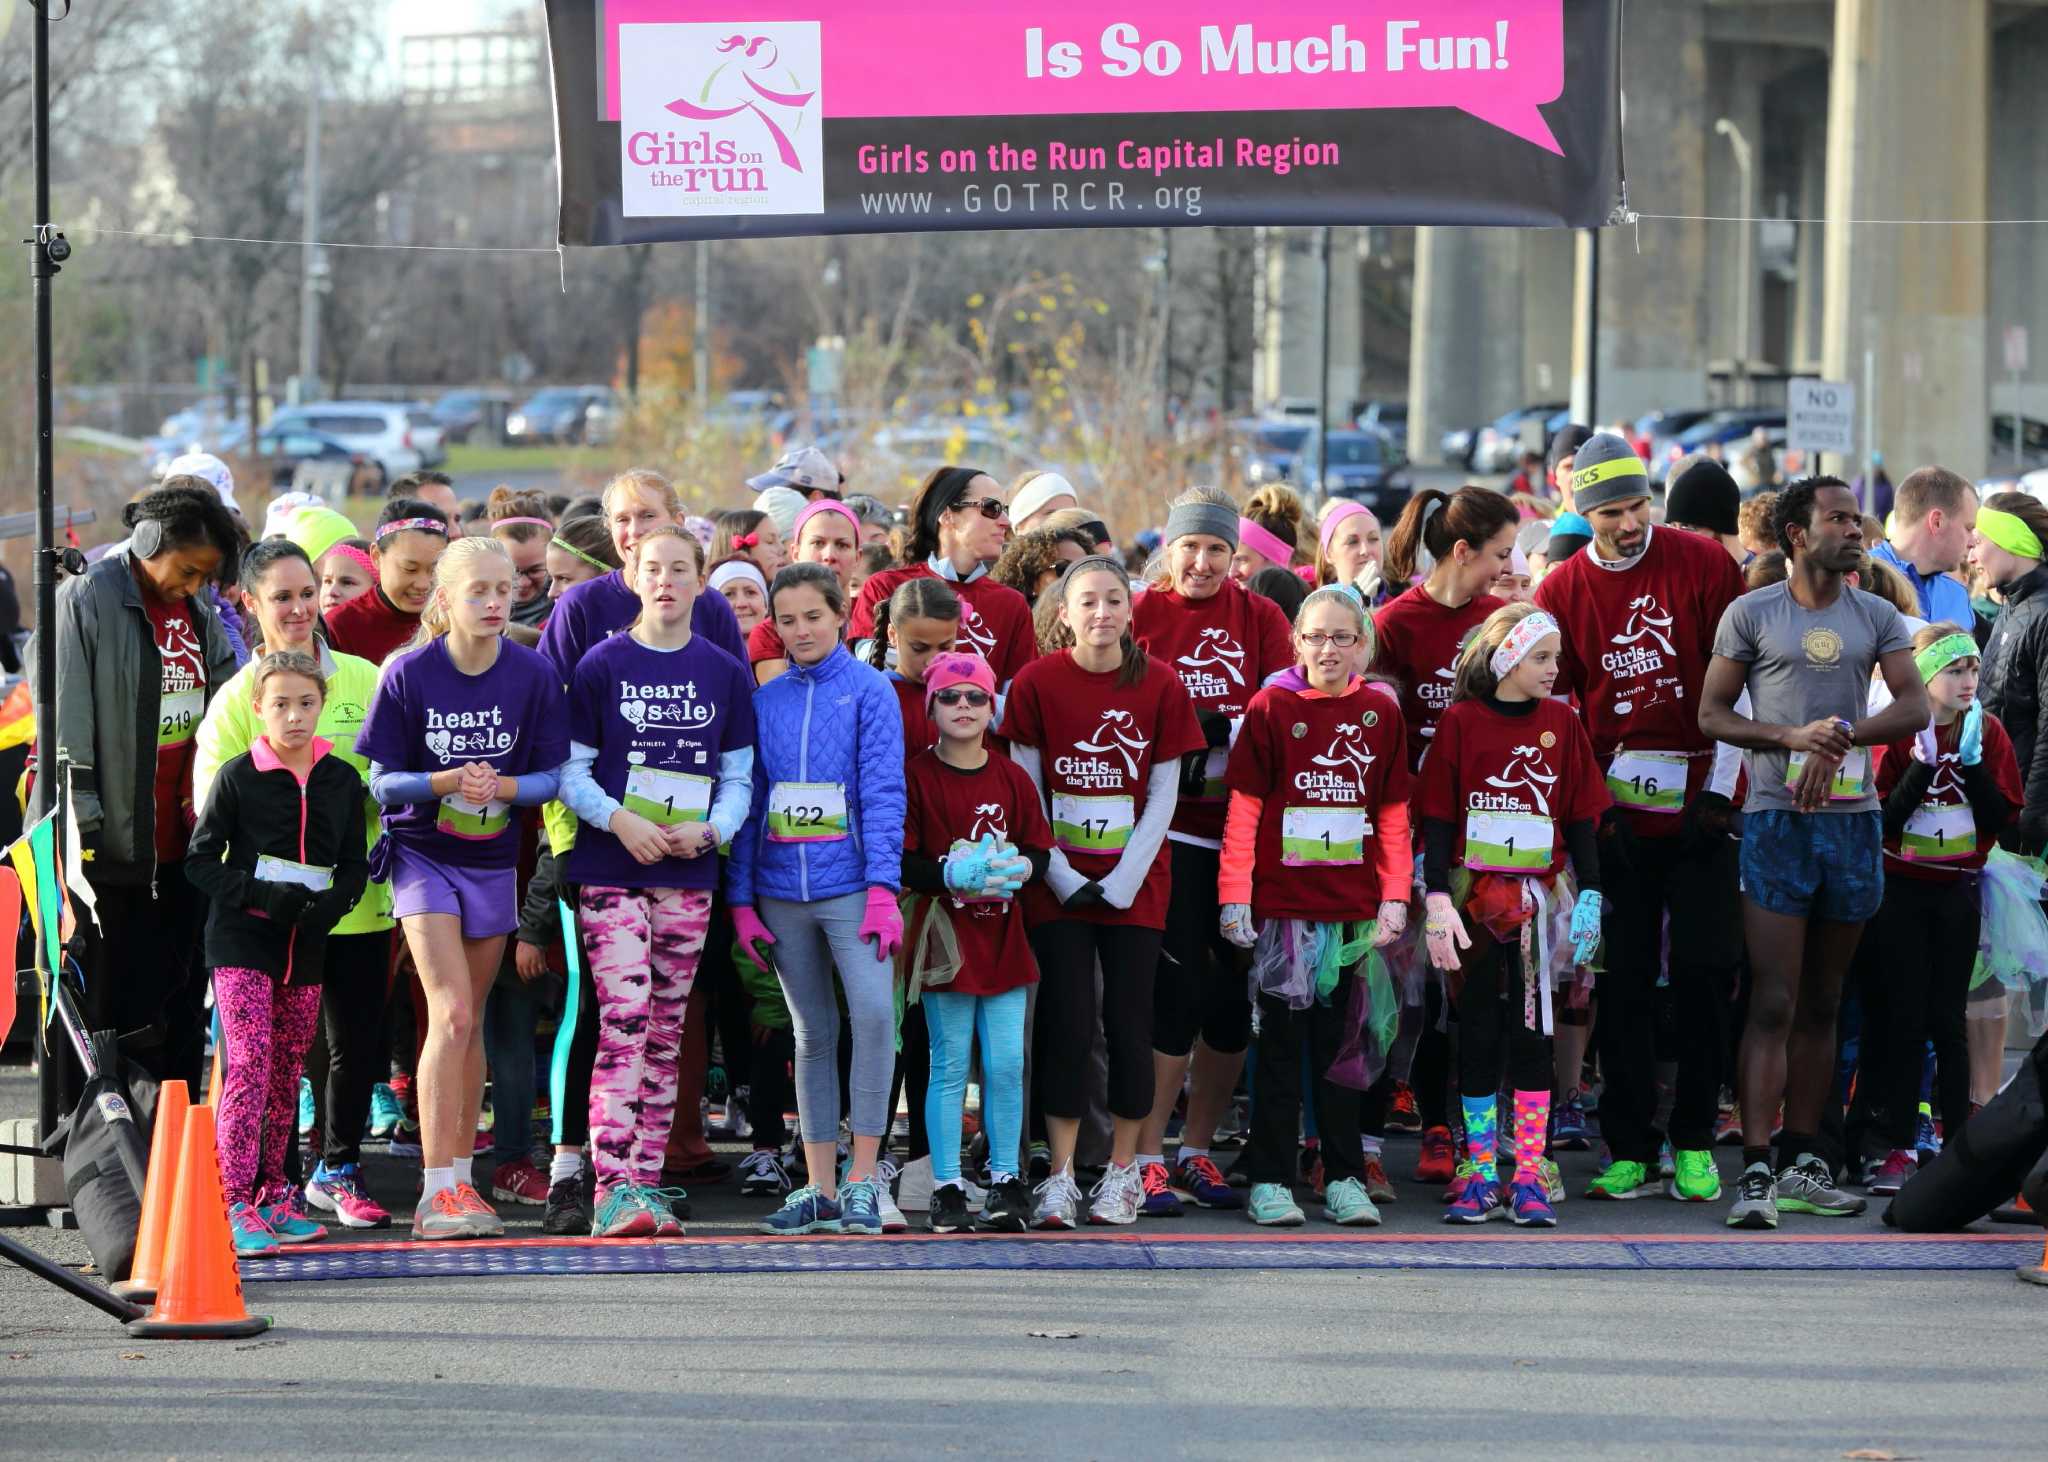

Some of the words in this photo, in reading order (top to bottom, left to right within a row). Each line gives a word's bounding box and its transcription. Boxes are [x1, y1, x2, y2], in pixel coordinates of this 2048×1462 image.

[1026, 27, 1083, 78] Is
[1101, 22, 1182, 77] So
[1200, 24, 1366, 75] Much
[1387, 20, 1509, 71] Fun!
[628, 131, 736, 166] Girls
[739, 152, 763, 164] on
[858, 145, 929, 174] Girls
[940, 149, 977, 172] on
[987, 143, 1037, 171] the
[1049, 142, 1106, 170] Run
[1117, 139, 1224, 176] Capital
[1236, 137, 1339, 175] Region
[651, 171, 684, 186] the
[684, 167, 768, 192] run
[1808, 389, 1838, 408] NO
[1574, 468, 1600, 488] SICS
[1602, 646, 1646, 671] Girls
[1646, 649, 1658, 657] on
[1613, 669, 1629, 679] the
[1627, 656, 1664, 678] run
[620, 680, 697, 699] heart
[1187, 683, 1230, 698] run
[1427, 700, 1444, 709] the
[162, 710, 191, 735] 219
[426, 705, 503, 729] heart
[1055, 756, 1109, 775] Girls
[1066, 776, 1083, 785] the
[1082, 775, 1124, 789] run
[1294, 770, 1343, 790] Girls
[1343, 781, 1356, 789] on
[1630, 775, 1658, 797] 16
[664, 795, 674, 816] 1
[1306, 790, 1321, 799] the
[1320, 788, 1358, 802] run
[1469, 791, 1520, 810] Girls
[478, 806, 488, 826] 1
[783, 805, 825, 827] 122
[1081, 818, 1109, 839] 17
[1934, 828, 1944, 848] 1
[1320, 830, 1330, 851] 1
[1504, 836, 1515, 857] 1
